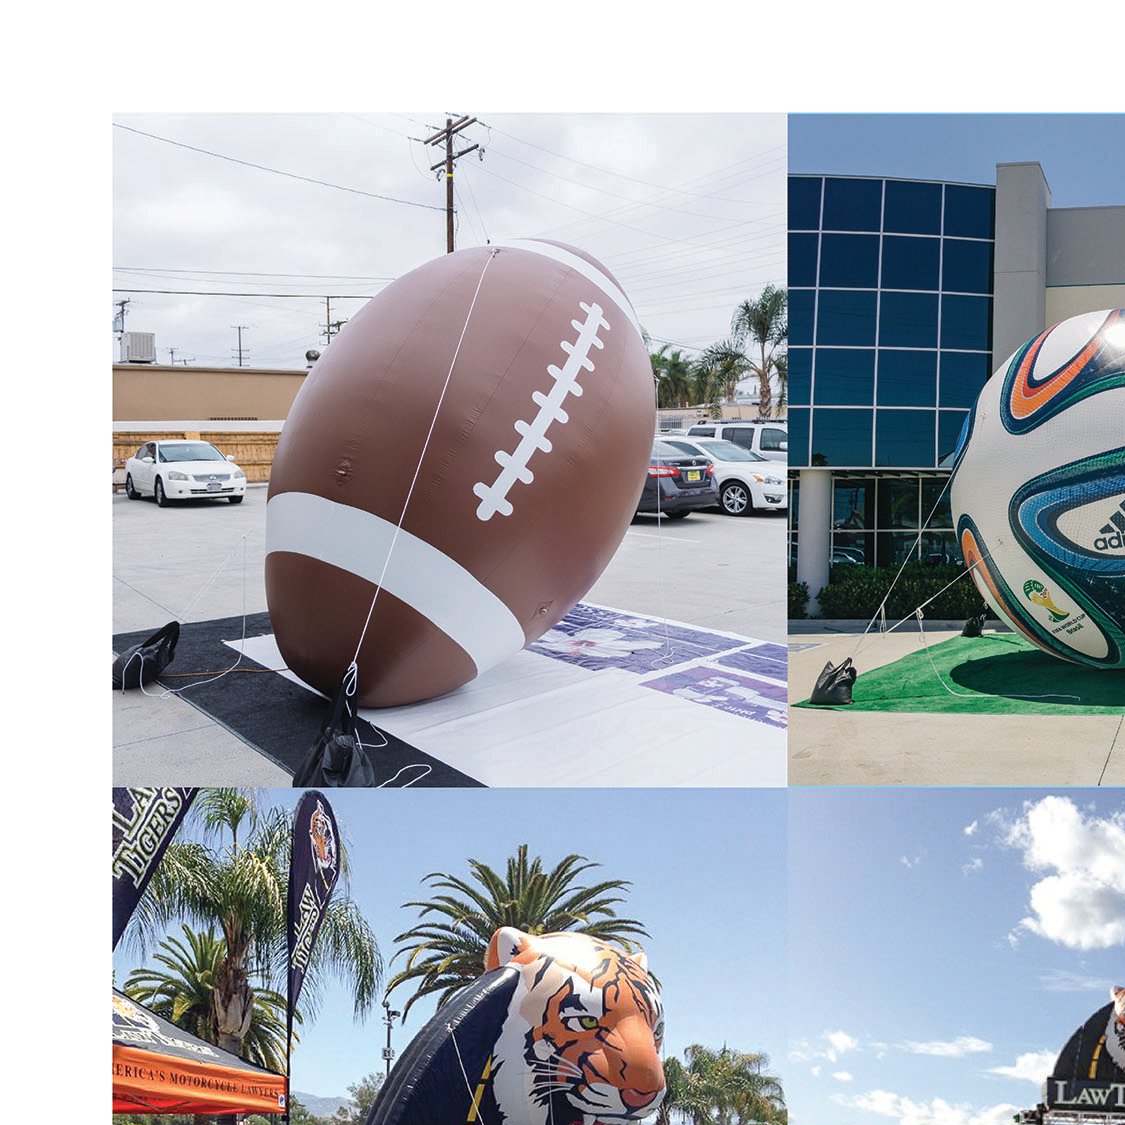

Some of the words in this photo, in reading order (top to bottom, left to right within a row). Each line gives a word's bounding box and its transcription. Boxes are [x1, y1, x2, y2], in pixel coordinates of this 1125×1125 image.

[112, 787, 182, 889] TIGERS
[170, 1072, 239, 1093] MOTORCYCLE
[241, 1083, 279, 1099] LAWYERS
